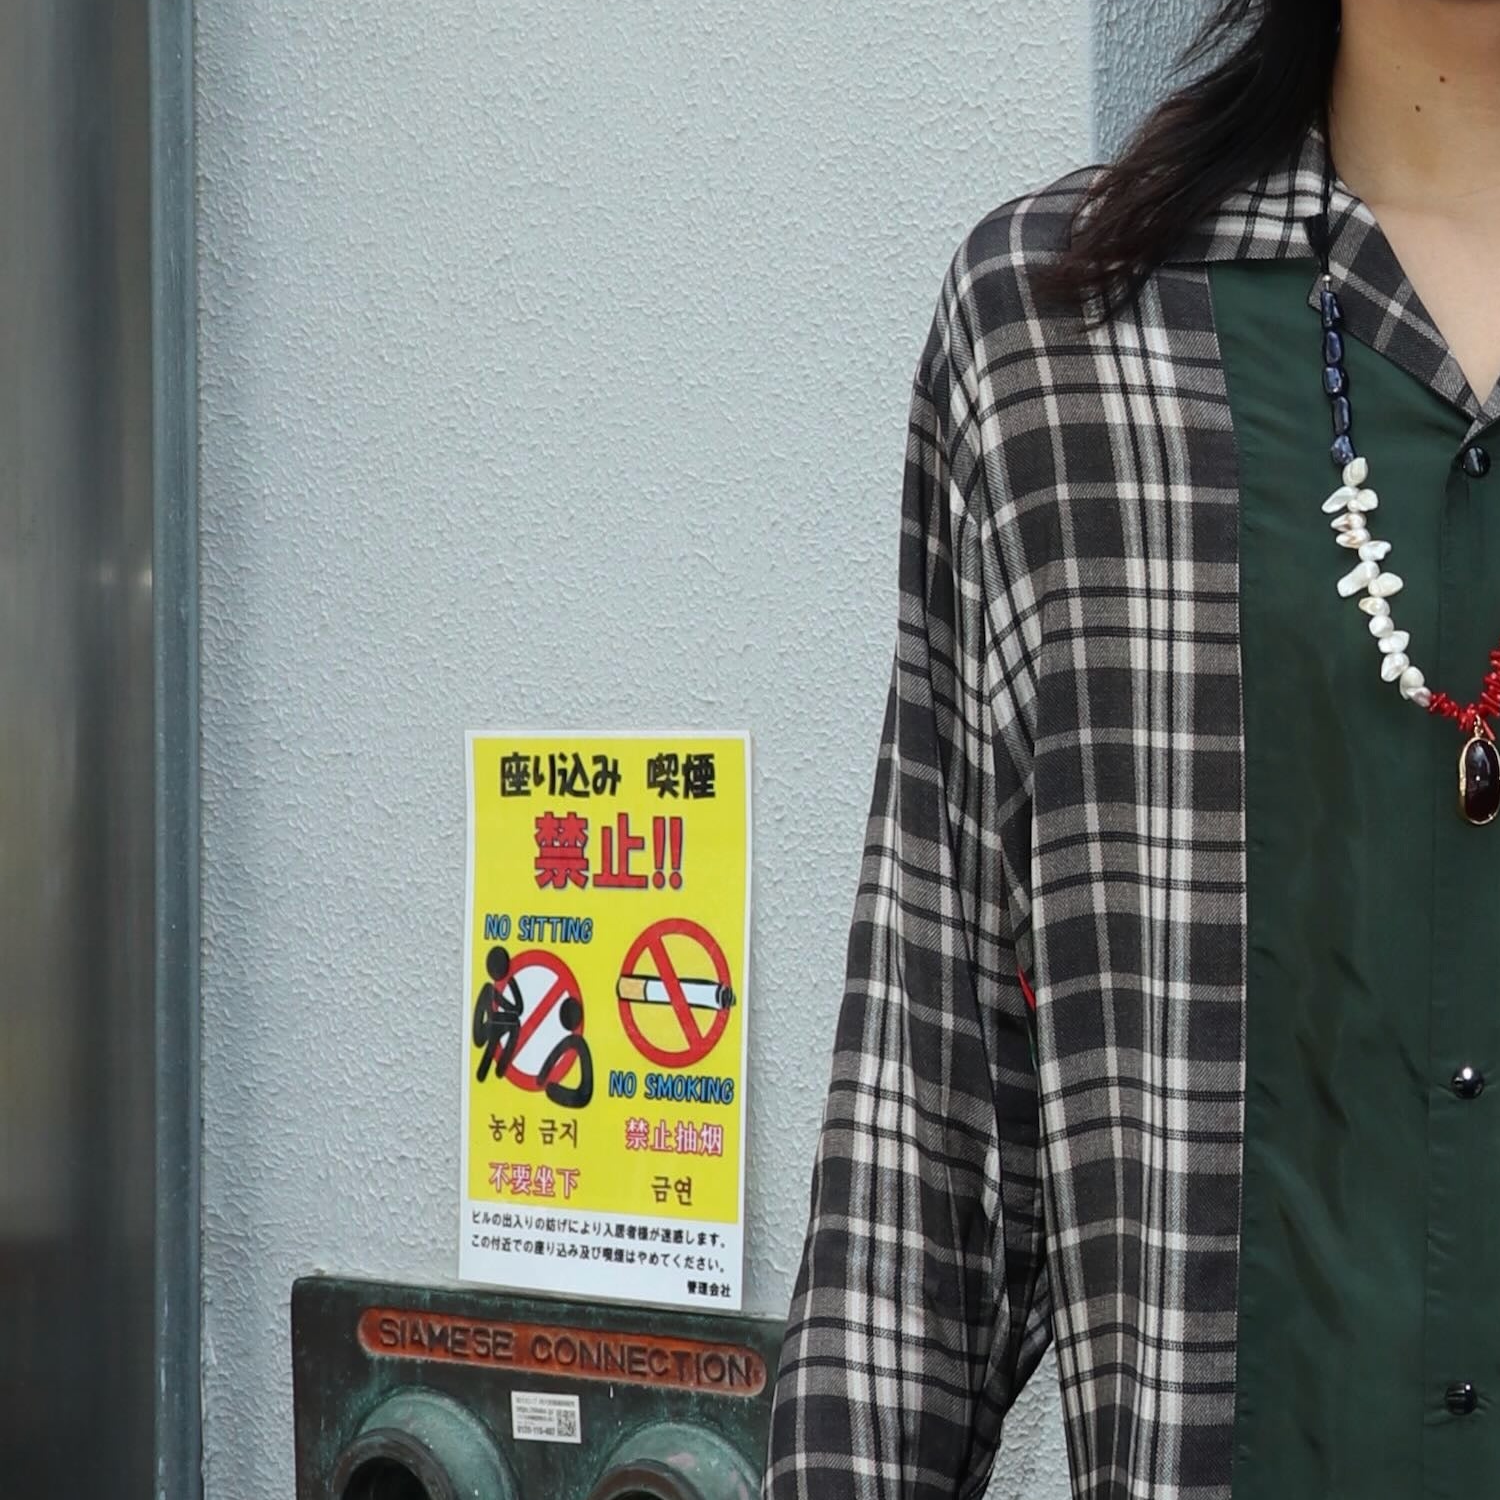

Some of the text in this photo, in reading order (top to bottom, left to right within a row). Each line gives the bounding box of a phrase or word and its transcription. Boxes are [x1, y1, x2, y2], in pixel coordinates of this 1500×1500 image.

[500, 752, 716, 799] 座り込み 喫煙
[484, 914, 593, 944] NO SITTING
[609, 1071, 734, 1105] NO SMOKING
[489, 1114, 578, 1148] 농성 금지
[625, 1117, 723, 1156] 禁止抽烟
[489, 1162, 580, 1199] 不要坐下
[651, 1175, 692, 1206] 금연
[687, 1280, 731, 1298] 管理会社
[379, 1318, 754, 1387] SIAMESE CONNECTION
